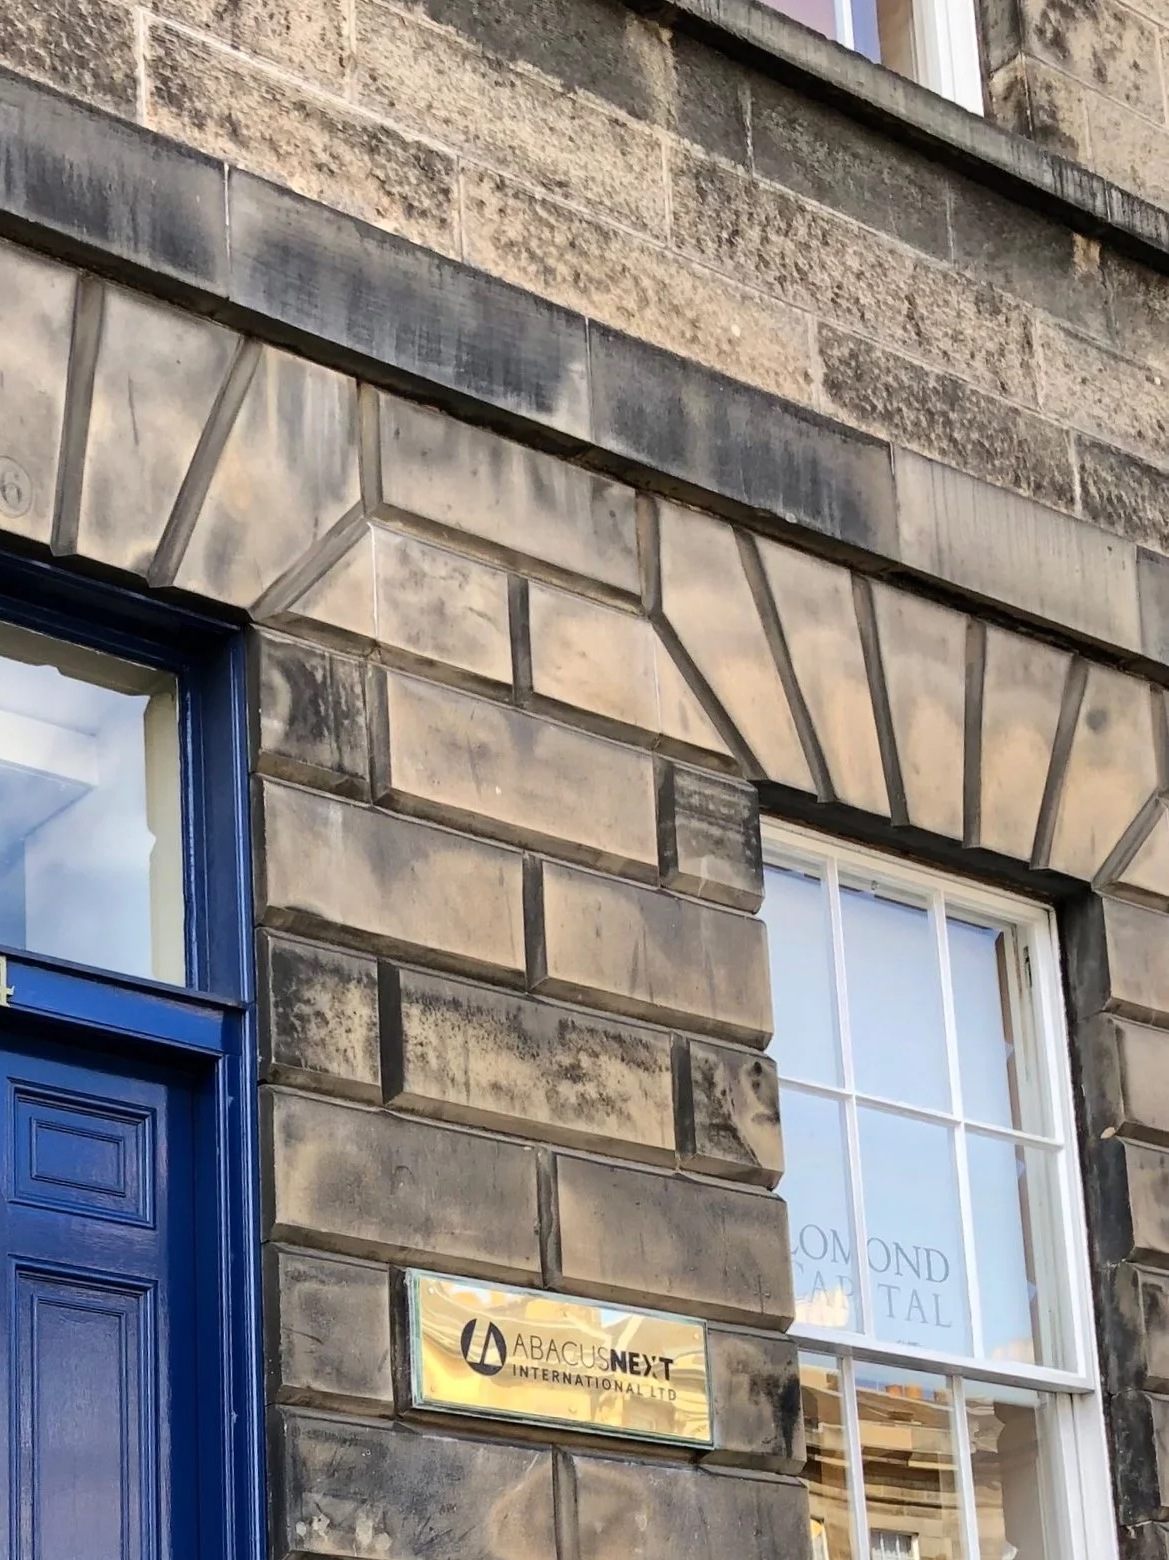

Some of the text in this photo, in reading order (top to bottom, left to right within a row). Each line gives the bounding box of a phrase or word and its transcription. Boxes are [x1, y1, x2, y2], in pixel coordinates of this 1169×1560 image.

[512, 1333, 675, 1381] ABACUSNEXT
[512, 1363, 677, 1401] INTERNATIONAL LTD
